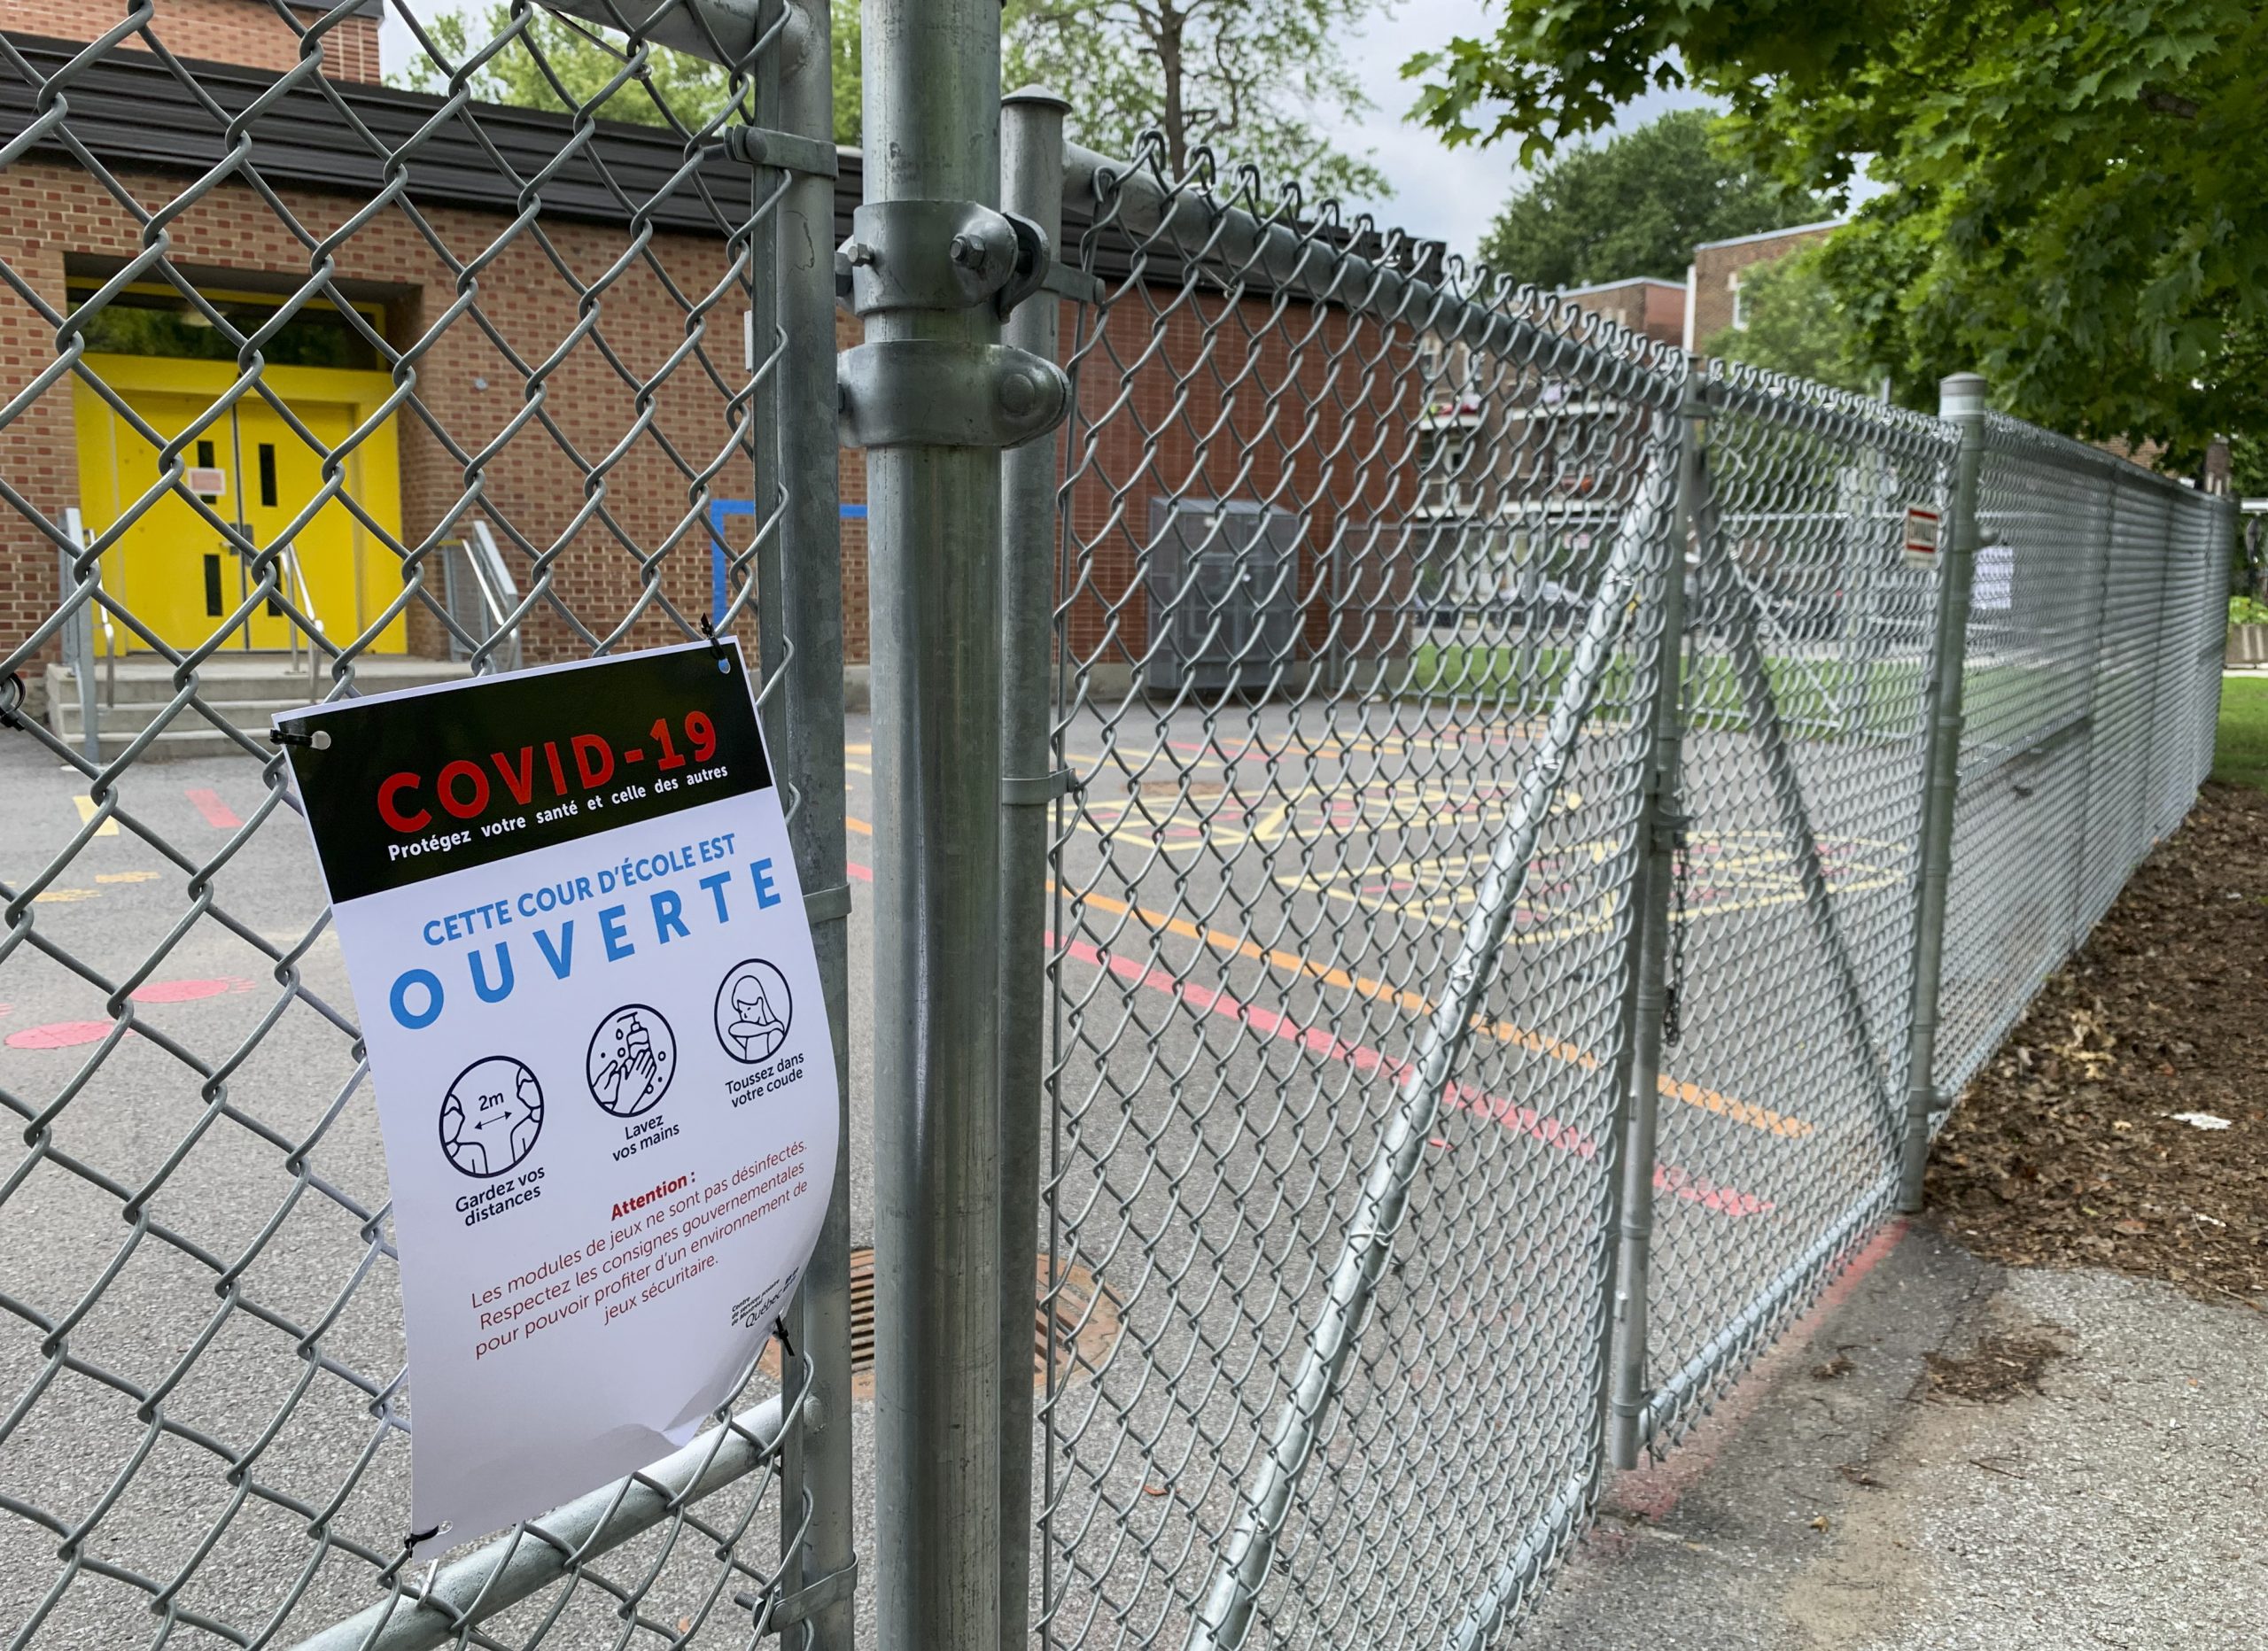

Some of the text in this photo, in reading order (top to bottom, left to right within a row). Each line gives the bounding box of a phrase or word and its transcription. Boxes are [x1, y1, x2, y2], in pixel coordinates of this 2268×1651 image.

[377, 710, 718, 833] COVID-19
[388, 765, 728, 861] Protégez votre santé et celle des autres
[423, 900, 512, 946] CETTE
[518, 877, 594, 918] COUR
[698, 833, 736, 863] EST
[390, 857, 781, 1030] OUVERTE
[478, 1092, 504, 1112] 2m
[726, 1052, 804, 1095] Toussez dans
[732, 1068, 803, 1108] votre coude
[612, 1123, 680, 1162] vos mains
[625, 1114, 664, 1140] Lavez
[455, 1167, 546, 1212] Gardez vos
[465, 1186, 541, 1226] distances
[610, 1174, 687, 1221] Attention
[472, 1139, 807, 1308] Les modules de jeux ne sont pas désinfectés.
[481, 1162, 804, 1329] Respectez les consignes gouvernementales
[475, 1327, 519, 1359] pour
[524, 1295, 589, 1338] pouvoir
[594, 1265, 651, 1306] profiter
[691, 1190, 790, 1252] environnement
[792, 1180, 808, 1198] de
[604, 1255, 718, 1325] jeux sécuritaire.
